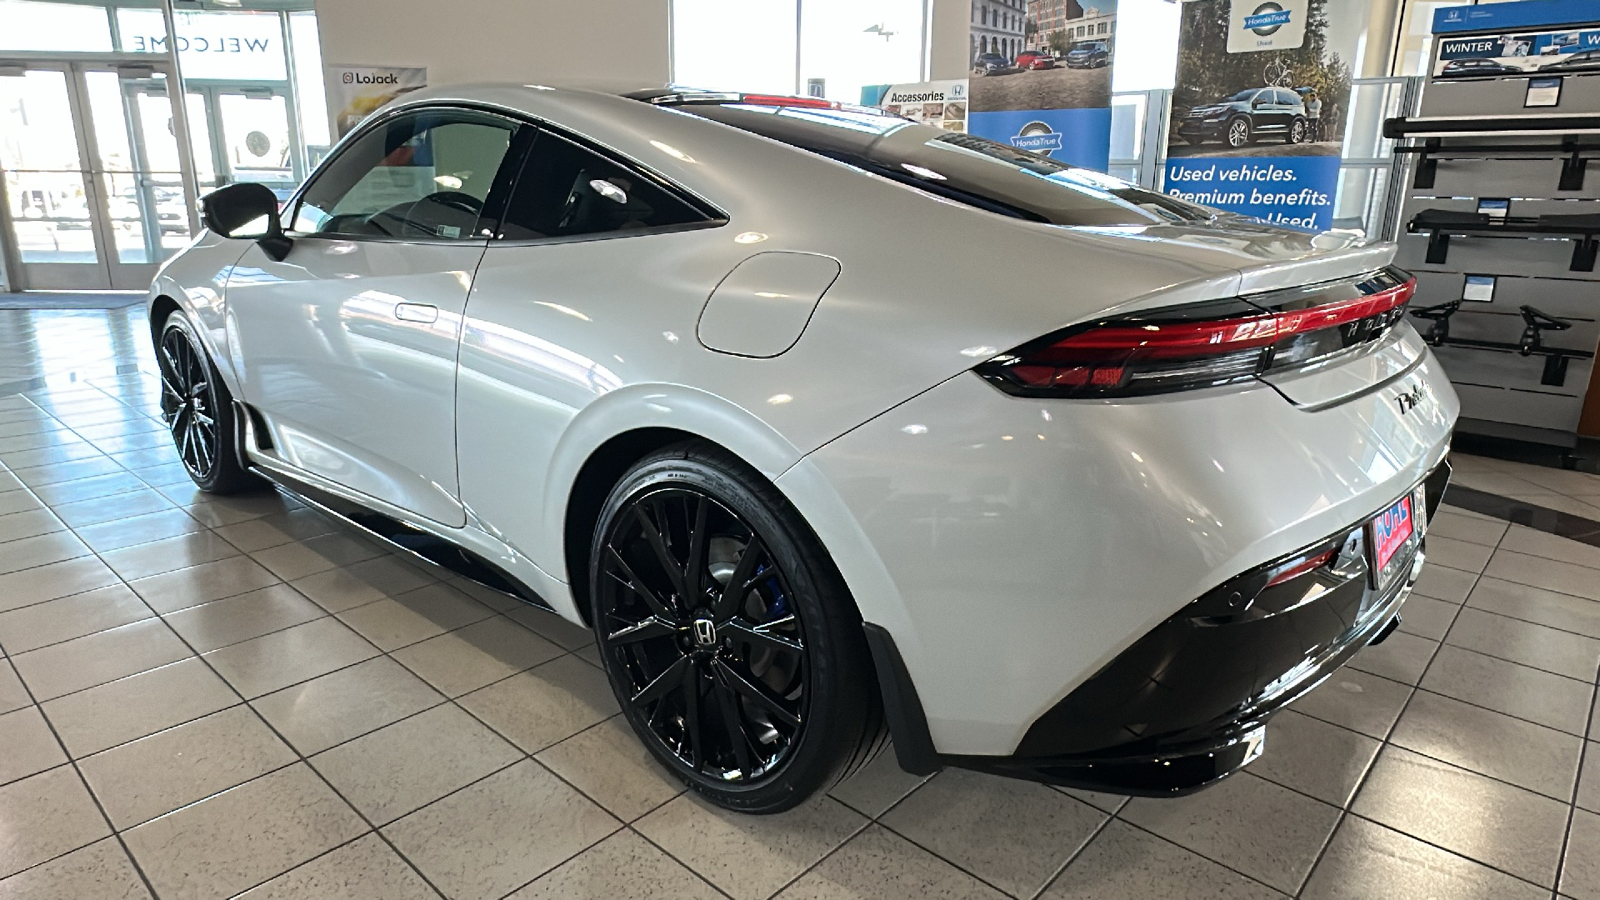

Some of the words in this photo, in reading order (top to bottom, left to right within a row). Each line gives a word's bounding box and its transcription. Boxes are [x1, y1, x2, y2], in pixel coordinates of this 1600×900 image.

[1247, 14, 1287, 26] HondaTrue
[1446, 41, 1493, 54] WINTER
[891, 91, 944, 103] Accessories
[1016, 137, 1056, 148] HondaTrue
[1170, 165, 1215, 181] Used
[1219, 164, 1297, 182] vehicles.
[1169, 188, 1245, 205] Premium
[1250, 187, 1331, 206] benefits.
